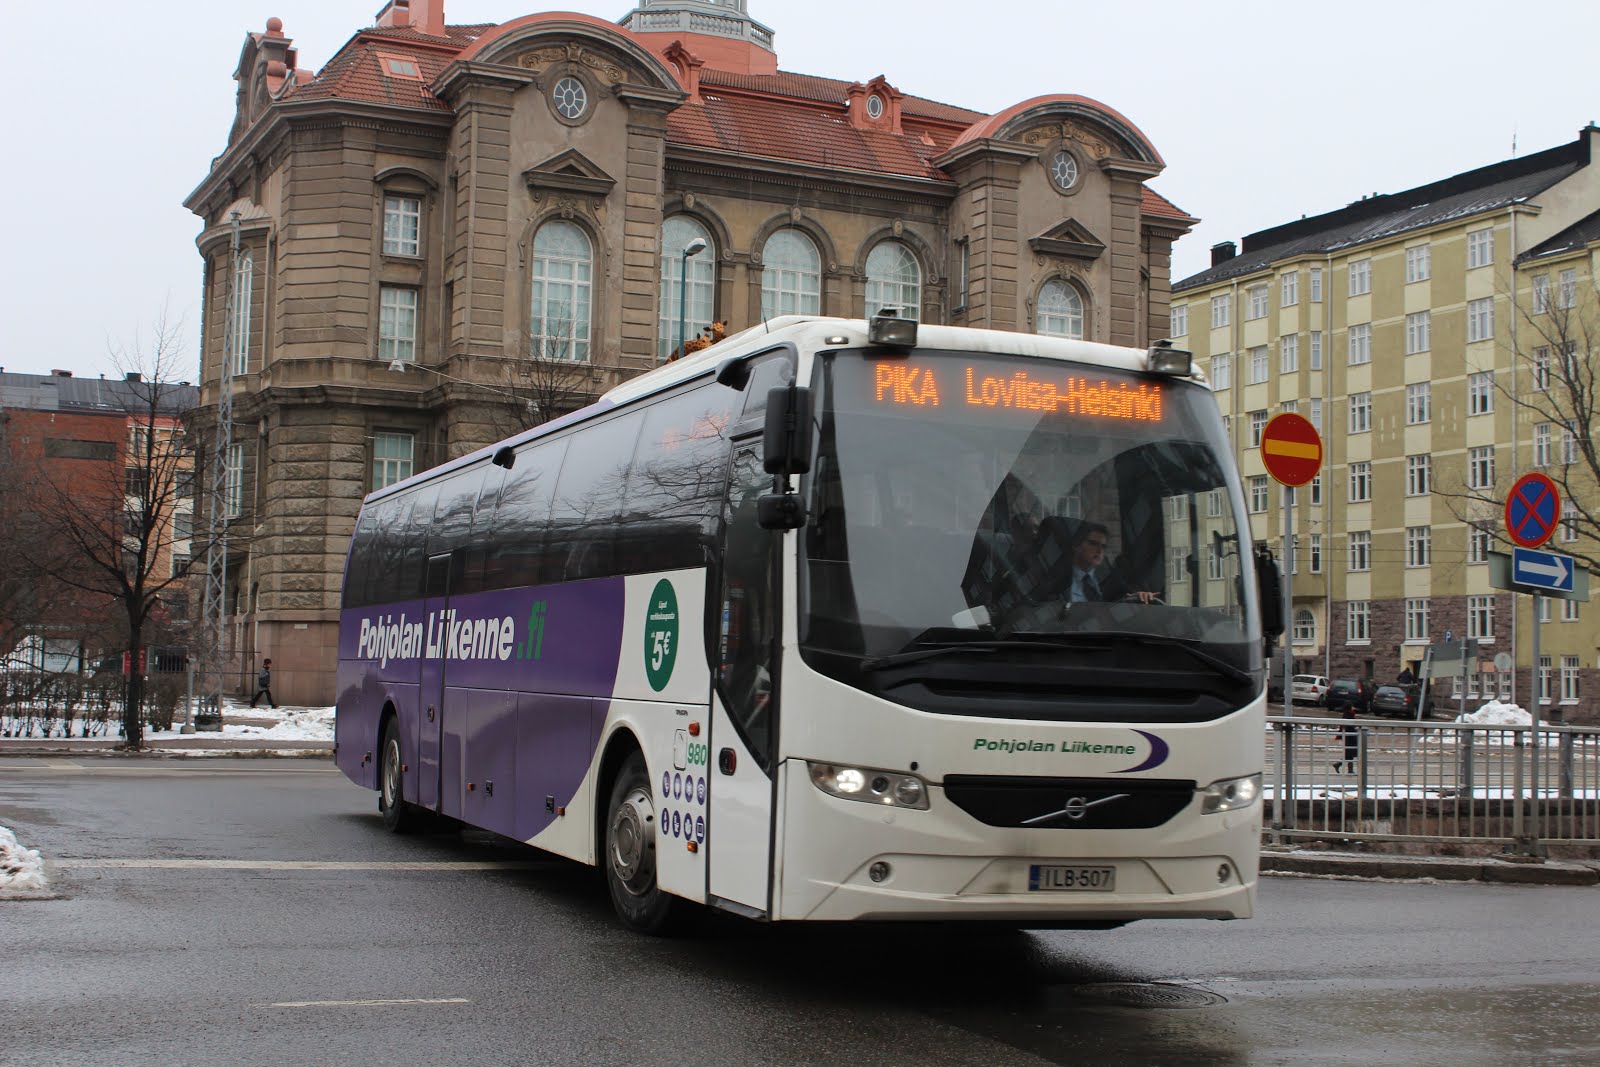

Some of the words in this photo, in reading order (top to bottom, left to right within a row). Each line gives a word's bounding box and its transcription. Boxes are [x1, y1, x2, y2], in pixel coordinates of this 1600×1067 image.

[876, 365, 939, 406] PIKA
[966, 367, 1161, 421] Loviisa-Helsinki
[357, 613, 424, 670] Pohjolan
[425, 608, 515, 661] Liikenne
[687, 742, 707, 766] 980
[973, 738, 1055, 754] Pohjolan
[1061, 741, 1136, 755] Liikenne
[1045, 869, 1111, 887] ILB-507
